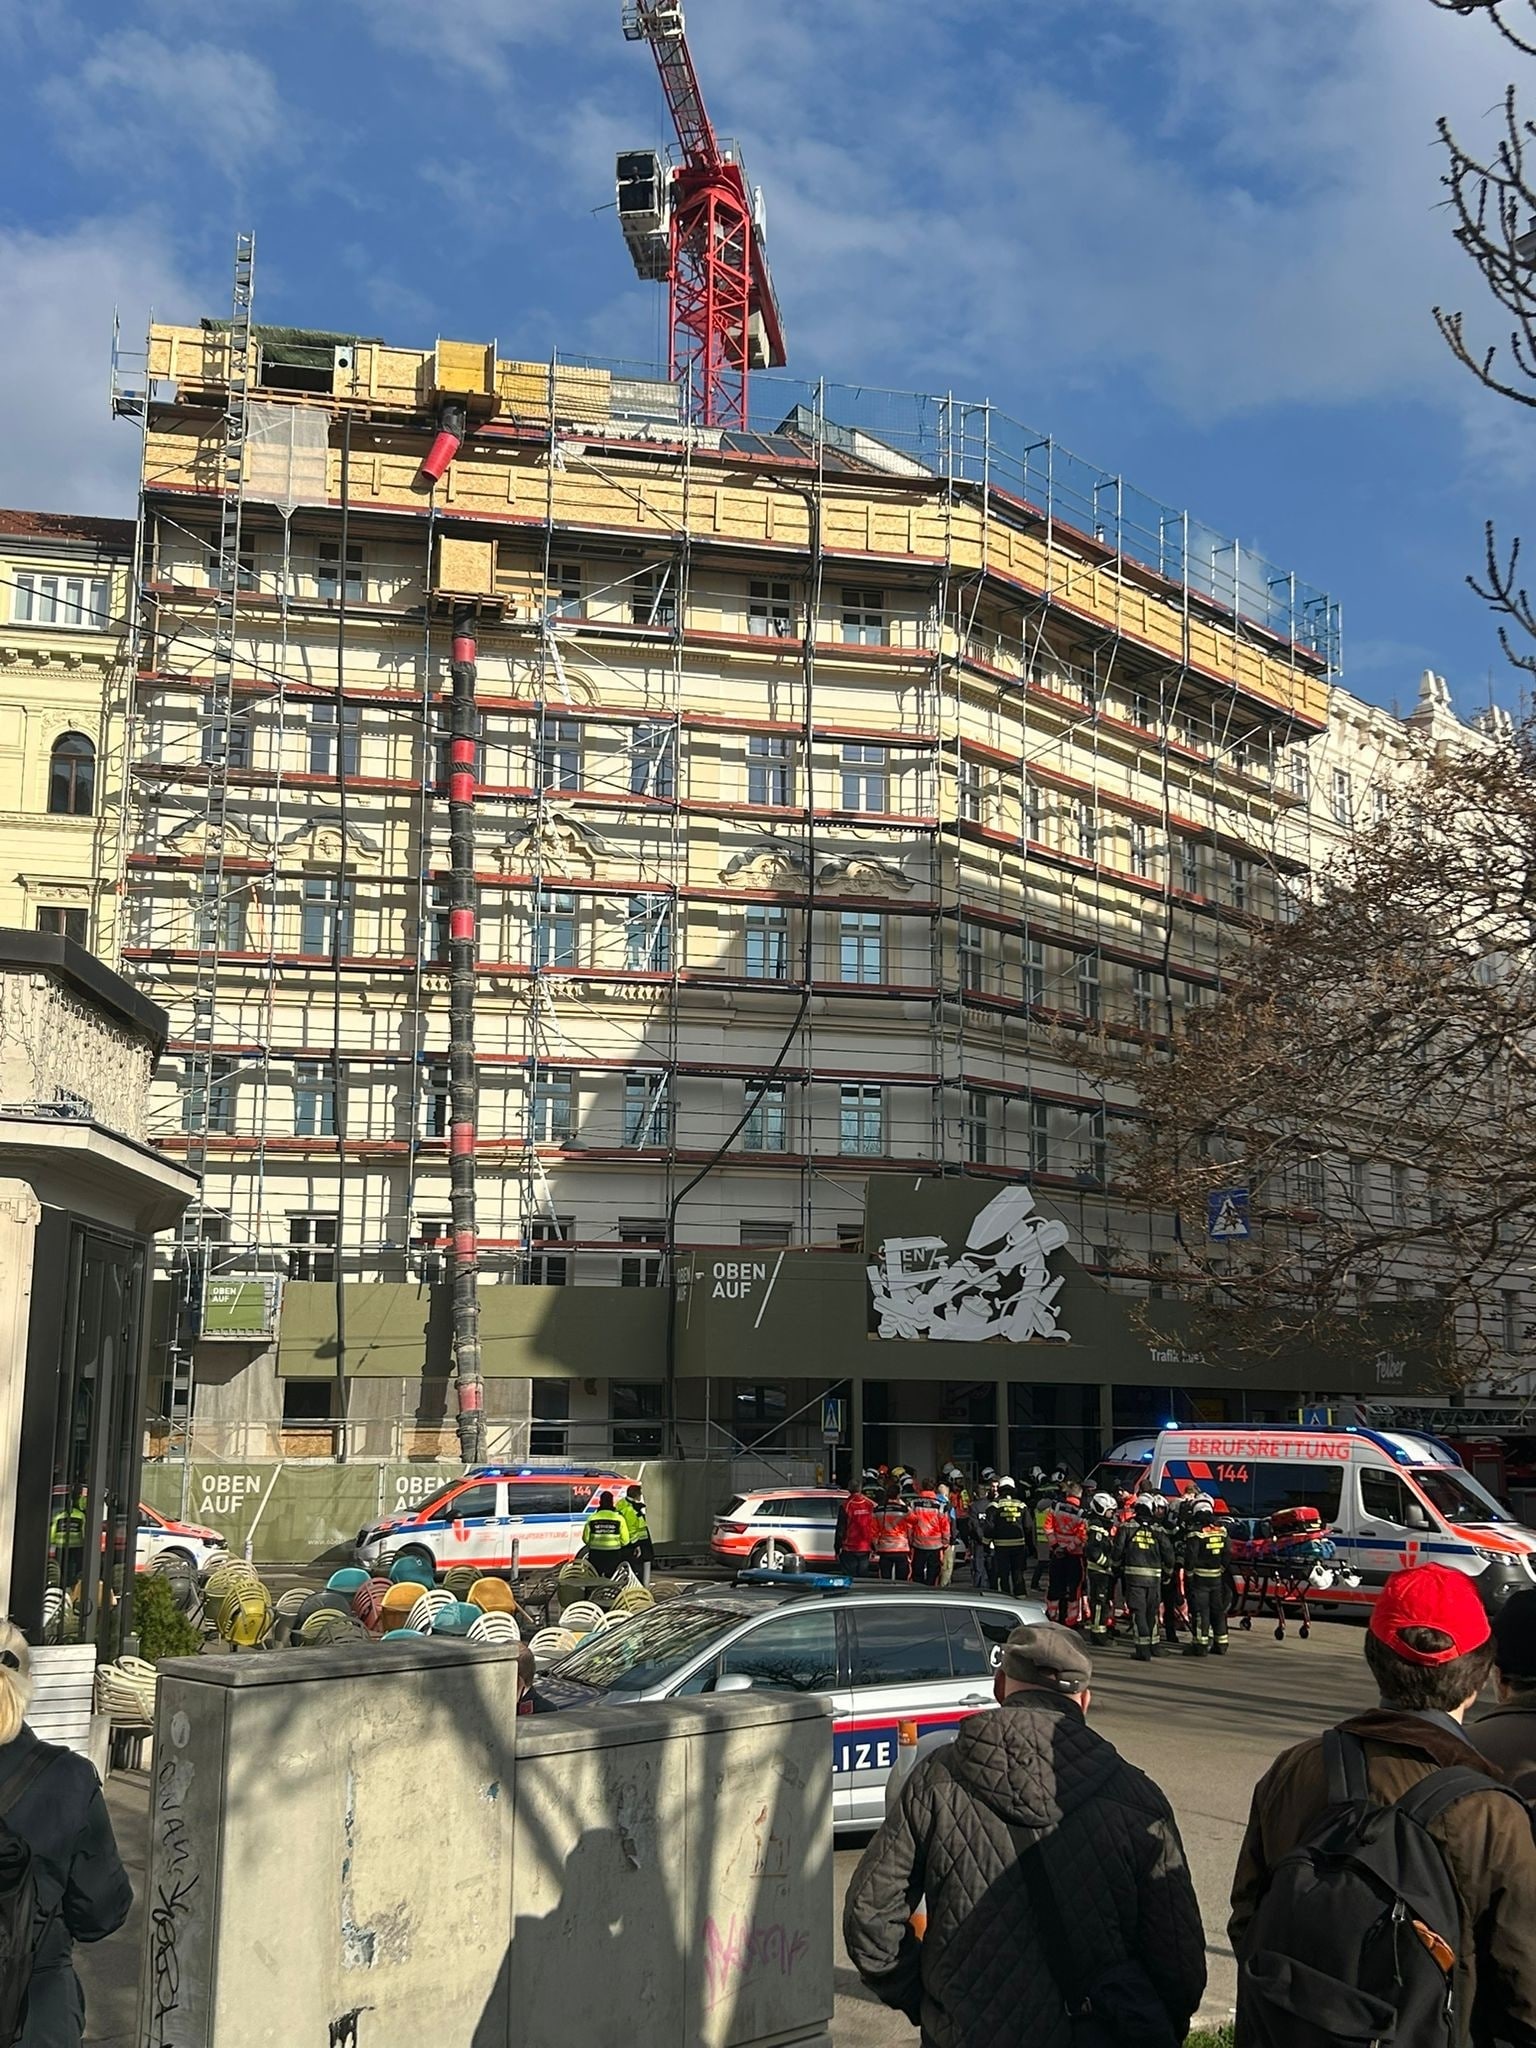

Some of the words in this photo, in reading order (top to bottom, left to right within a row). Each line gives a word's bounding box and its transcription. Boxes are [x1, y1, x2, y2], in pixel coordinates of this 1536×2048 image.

[713, 1262, 766, 1280] OBEN
[211, 1295, 230, 1303] AUF
[212, 1287, 237, 1295] OBEN
[712, 1281, 752, 1299] AUF
[1150, 1348, 1180, 1363] Trafik
[1187, 1438, 1351, 1461] BERUFSRETTUNG
[1216, 1464, 1249, 1483] 144
[201, 1474, 261, 1494] OBEN
[572, 1485, 592, 1496] 144
[200, 1495, 244, 1514] AUF
[833, 1741, 891, 1773] IZE
